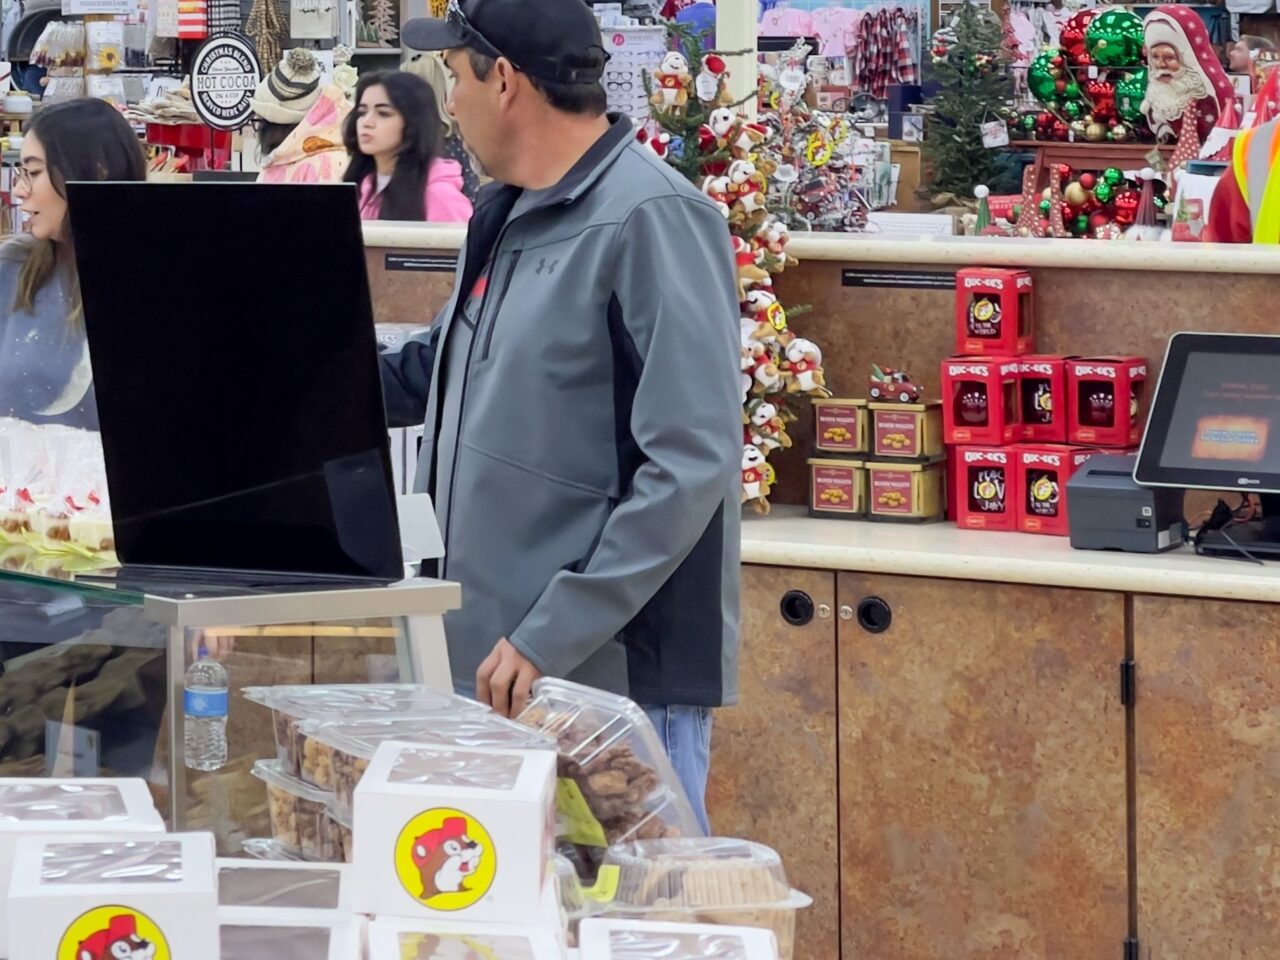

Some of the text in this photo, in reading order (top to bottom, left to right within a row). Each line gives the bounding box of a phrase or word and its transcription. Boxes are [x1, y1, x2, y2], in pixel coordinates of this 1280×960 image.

[201, 46, 252, 74] CHRISTMAS BLEND
[197, 74, 257, 89] HOT COCOA
[201, 90, 252, 118] SERVED HERE DAILY
[1020, 363, 1053, 375] C-EE'S
[978, 469, 1003, 482] PEAC
